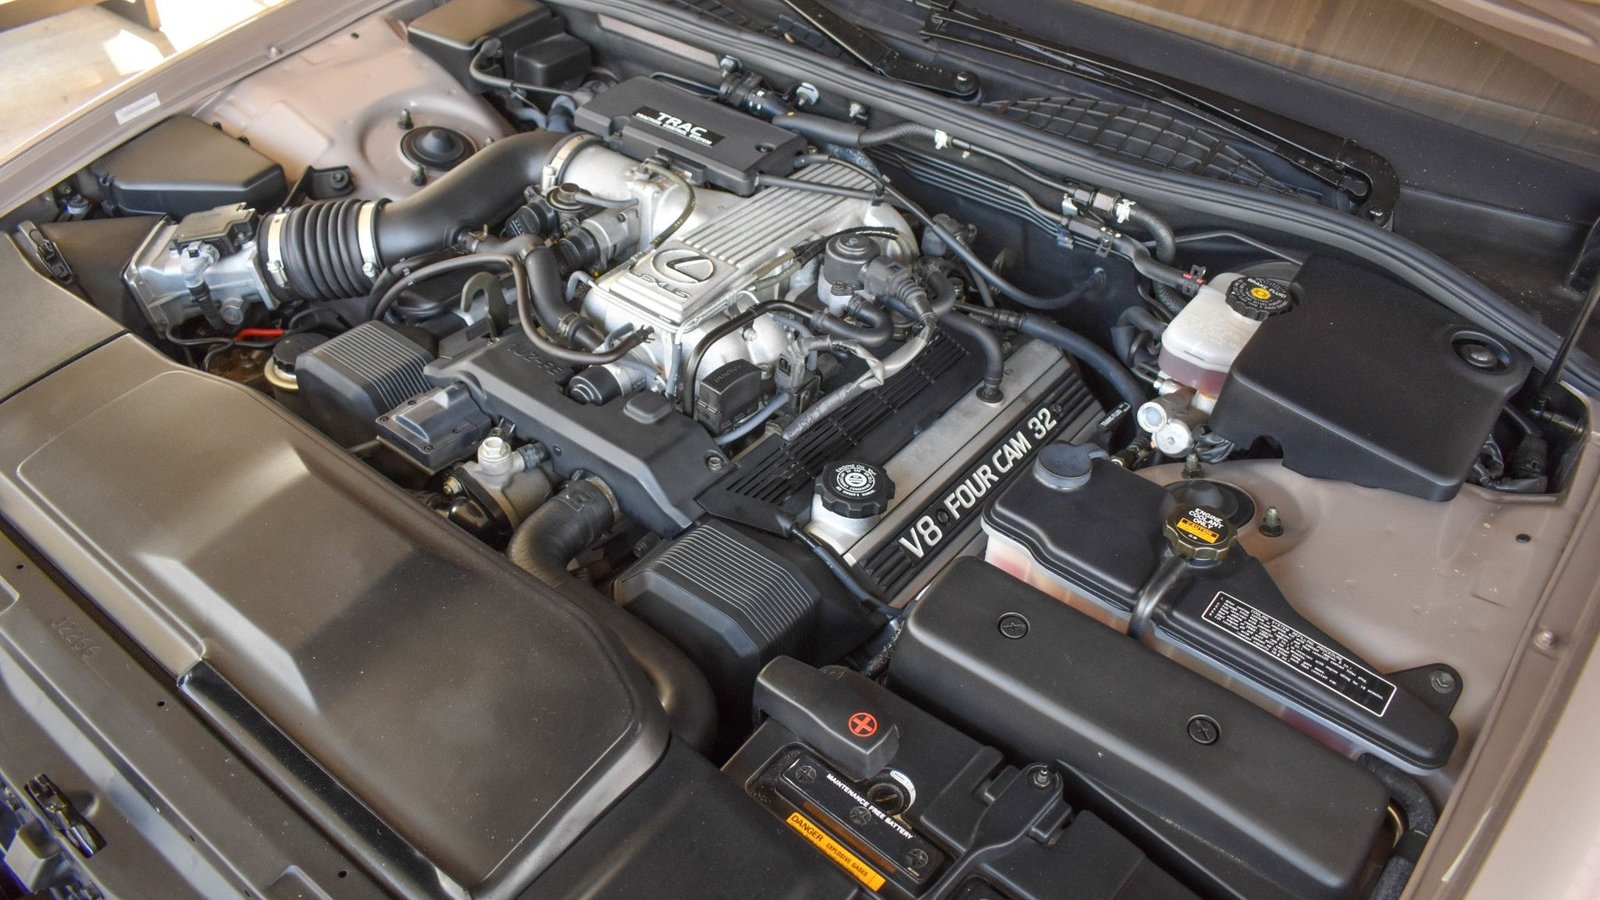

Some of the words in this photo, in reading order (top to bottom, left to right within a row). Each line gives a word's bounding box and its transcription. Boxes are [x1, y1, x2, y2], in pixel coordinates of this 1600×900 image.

[656, 112, 708, 136] TRAC
[1247, 278, 1269, 289] BRAKE
[1268, 288, 1287, 299] FLUID
[898, 515, 943, 559] V8
[943, 464, 999, 520] FOUR
[991, 431, 1032, 474] CAM
[1027, 407, 1057, 440] 32
[1188, 510, 1224, 529] COOLANT
[1193, 518, 1213, 529] ONLY
[1194, 507, 1223, 522] ENGINE
[826, 772, 870, 808] MAINTENANCE
[868, 800, 887, 820] FREE
[884, 814, 914, 841] BATTERY
[791, 814, 824, 842] DANGER
